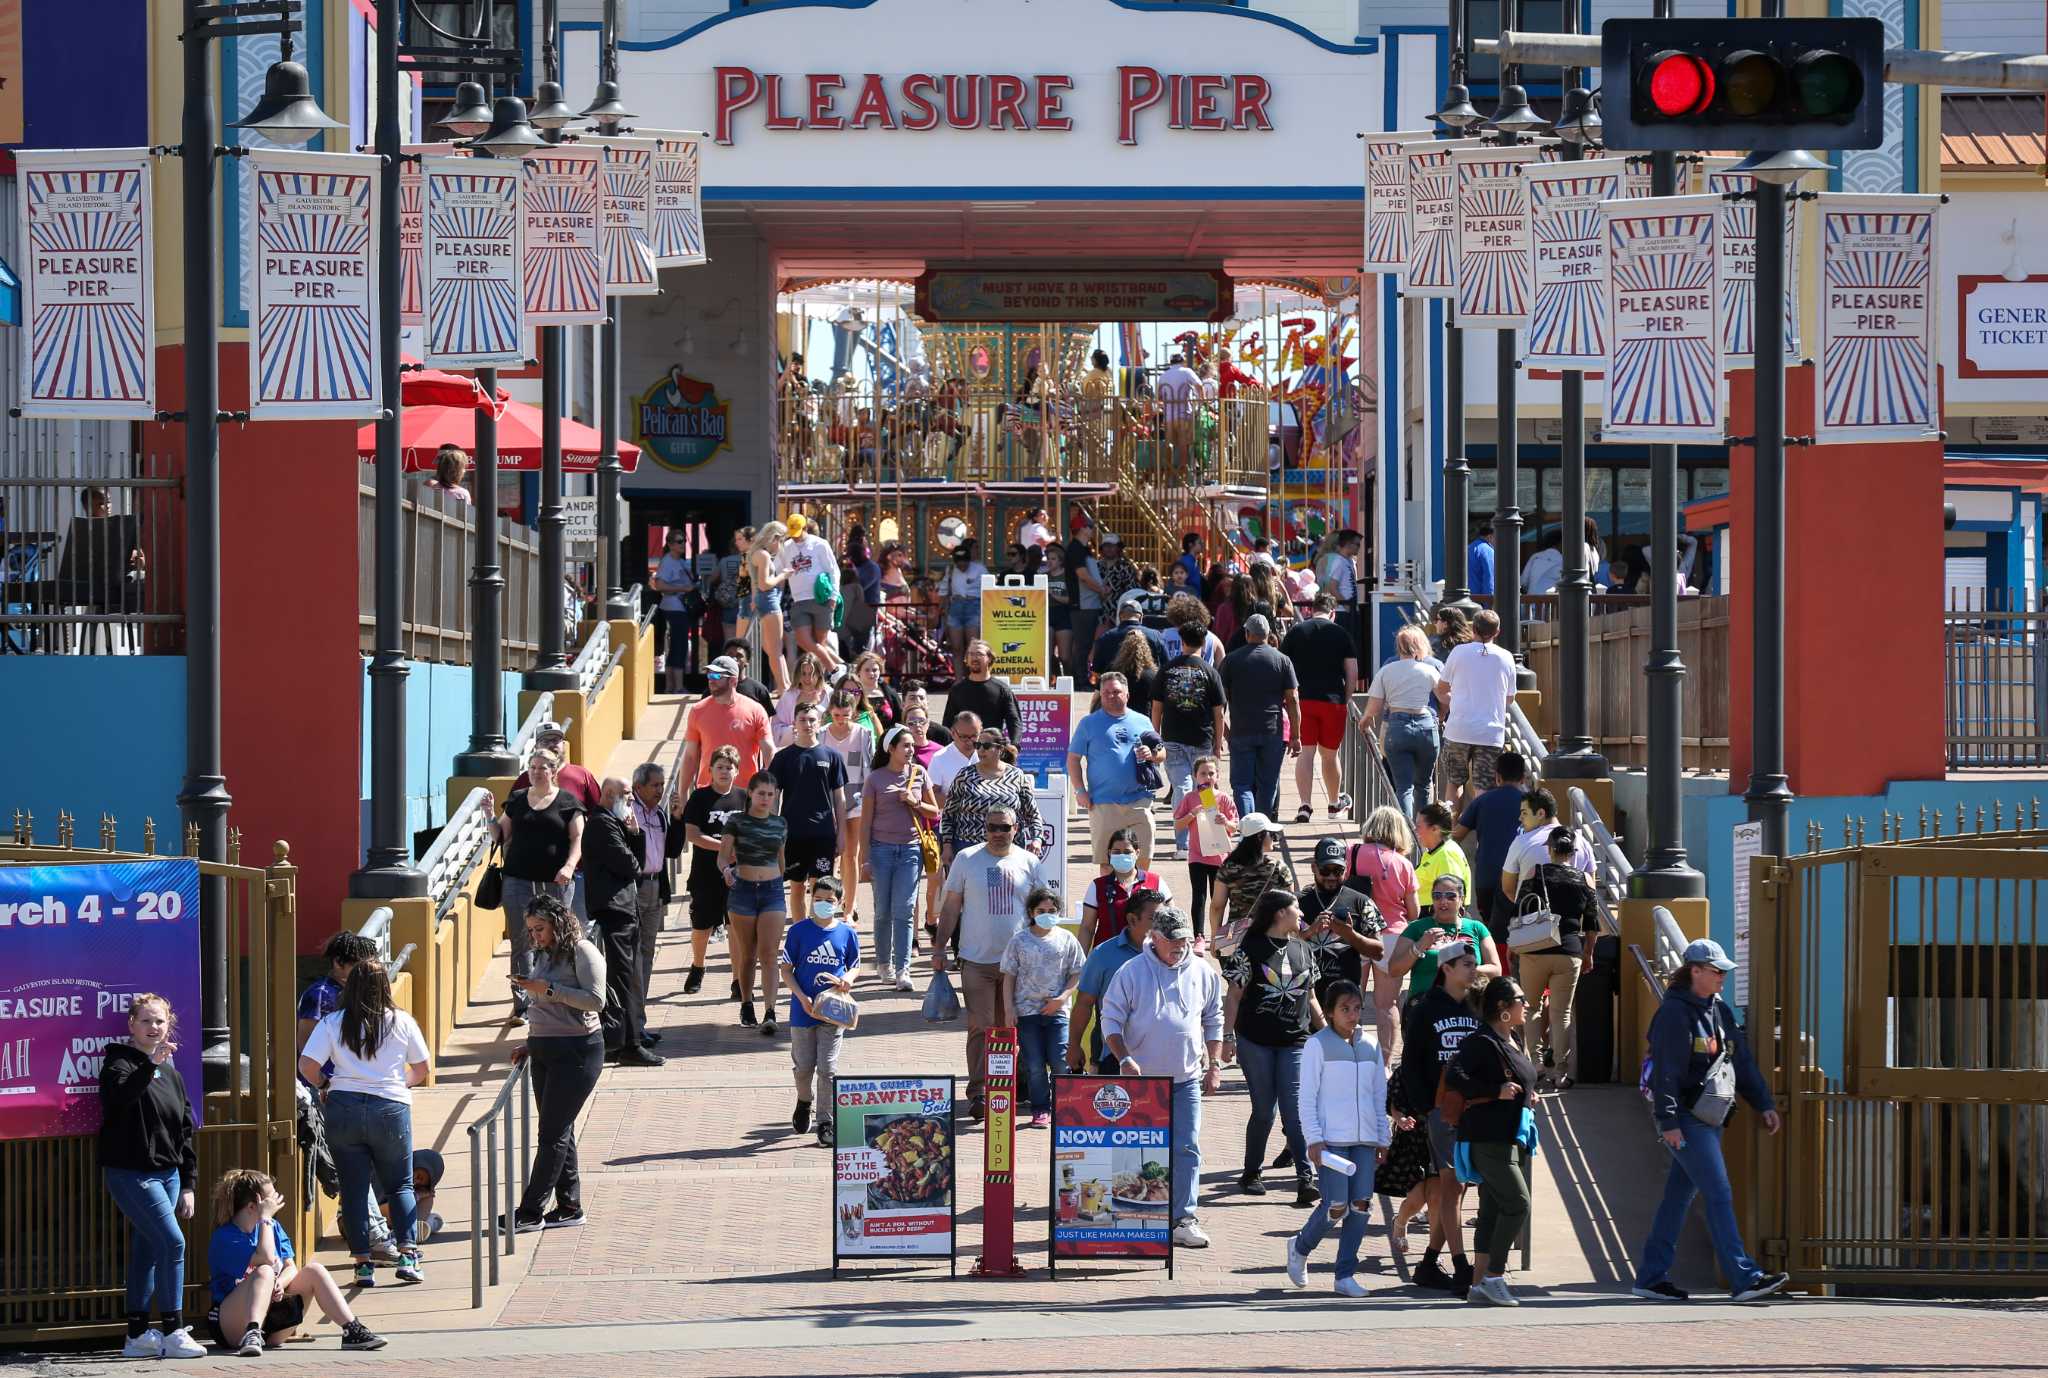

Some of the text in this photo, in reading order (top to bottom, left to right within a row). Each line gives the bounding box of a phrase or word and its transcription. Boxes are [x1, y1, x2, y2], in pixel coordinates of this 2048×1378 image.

[713, 65, 1274, 145] PLEASURE PIER
[655, 185, 693, 195] EASURE
[1373, 188, 1405, 198] PLEAS
[603, 199, 646, 211] EASURE
[657, 196, 678, 206] PIER
[1416, 203, 1453, 215] PLEAS
[527, 216, 594, 229] PLEASURE
[605, 213, 631, 223] PIER
[1464, 220, 1526, 232] PLEASUR
[547, 231, 576, 243] PIER
[1483, 235, 1512, 246] PIER
[435, 243, 512, 257] PLEASURE
[1539, 245, 1602, 260] PLEASUR
[1723, 243, 1756, 257] LEAS
[39, 257, 138, 275] PLEASURE
[266, 259, 364, 277] PLEASURE
[456, 260, 489, 274] PIER
[1562, 263, 1592, 276] PIER
[1735, 261, 1756, 274] PIE
[68, 280, 109, 297] PIER
[294, 282, 336, 298] PIER
[983, 282, 1167, 294] MUST HAVE A WRISTBAND
[1003, 296, 1147, 309] BEYOND THIS POINT
[1619, 295, 1710, 313] PLEASURE
[1831, 294, 1923, 310] PLEASURE
[1646, 316, 1685, 332] PIER
[1857, 314, 1896, 330] PIER
[642, 405, 725, 440] Pelican's Bag
[496, 455, 523, 464] UMP
[992, 610, 1037, 618] WILL CALL
[991, 666, 1037, 675] ADMISSION
[1018, 700, 1058, 711] RING
[1021, 711, 1050, 722] EAK
[1047, 879, 1060, 889] PEN
[77, 894, 101, 923] 4
[136, 891, 181, 920] 20
[806, 954, 840, 967] adidas
[13, 979, 51, 993] GALVESTON
[75, 979, 103, 990] HISTORIC
[840, 1079, 924, 1093] MAMA GUMP'S
[838, 1088, 944, 1106] CRAWFISH
[921, 1098, 951, 1114] Boil
[991, 1099, 1008, 1109] STOP
[1059, 1130, 1164, 1145] NOW OPEN
[837, 1151, 872, 1161] GET IT
[837, 1161, 877, 1171] BY THE
[837, 1172, 880, 1181] POUND!
[1056, 1231, 1167, 1239] JUST LIKE MAMA MAKES IT!
